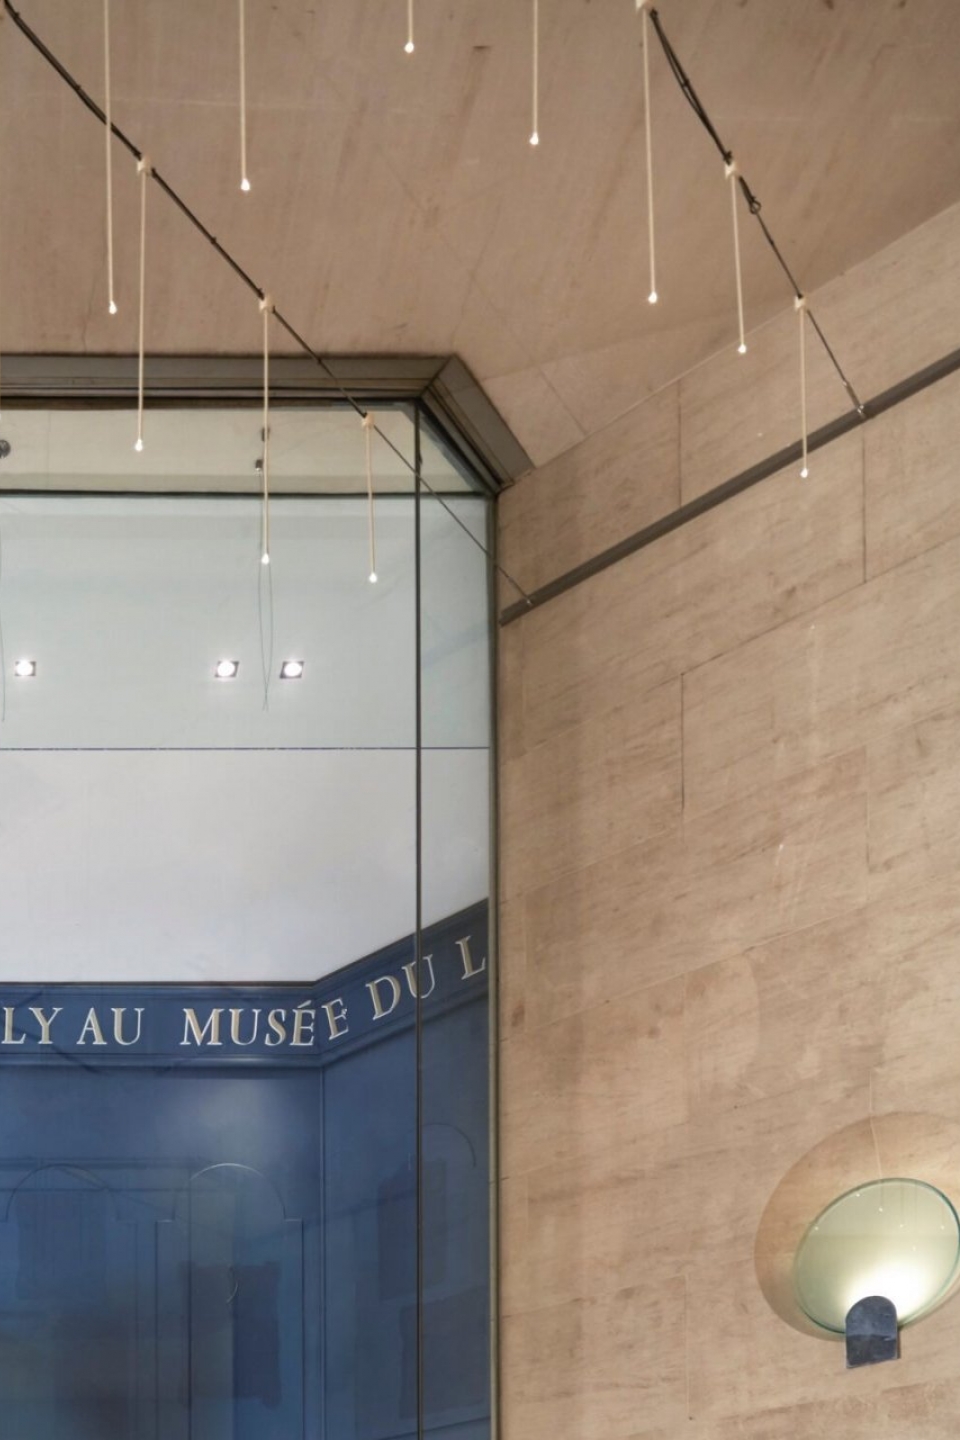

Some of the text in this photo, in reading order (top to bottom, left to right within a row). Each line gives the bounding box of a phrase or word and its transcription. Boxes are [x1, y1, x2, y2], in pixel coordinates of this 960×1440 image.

[76, 1007, 145, 1046] AU
[179, 998, 350, 1047] MUSÉE
[365, 954, 436, 1021] DU
[455, 935, 486, 980] L
